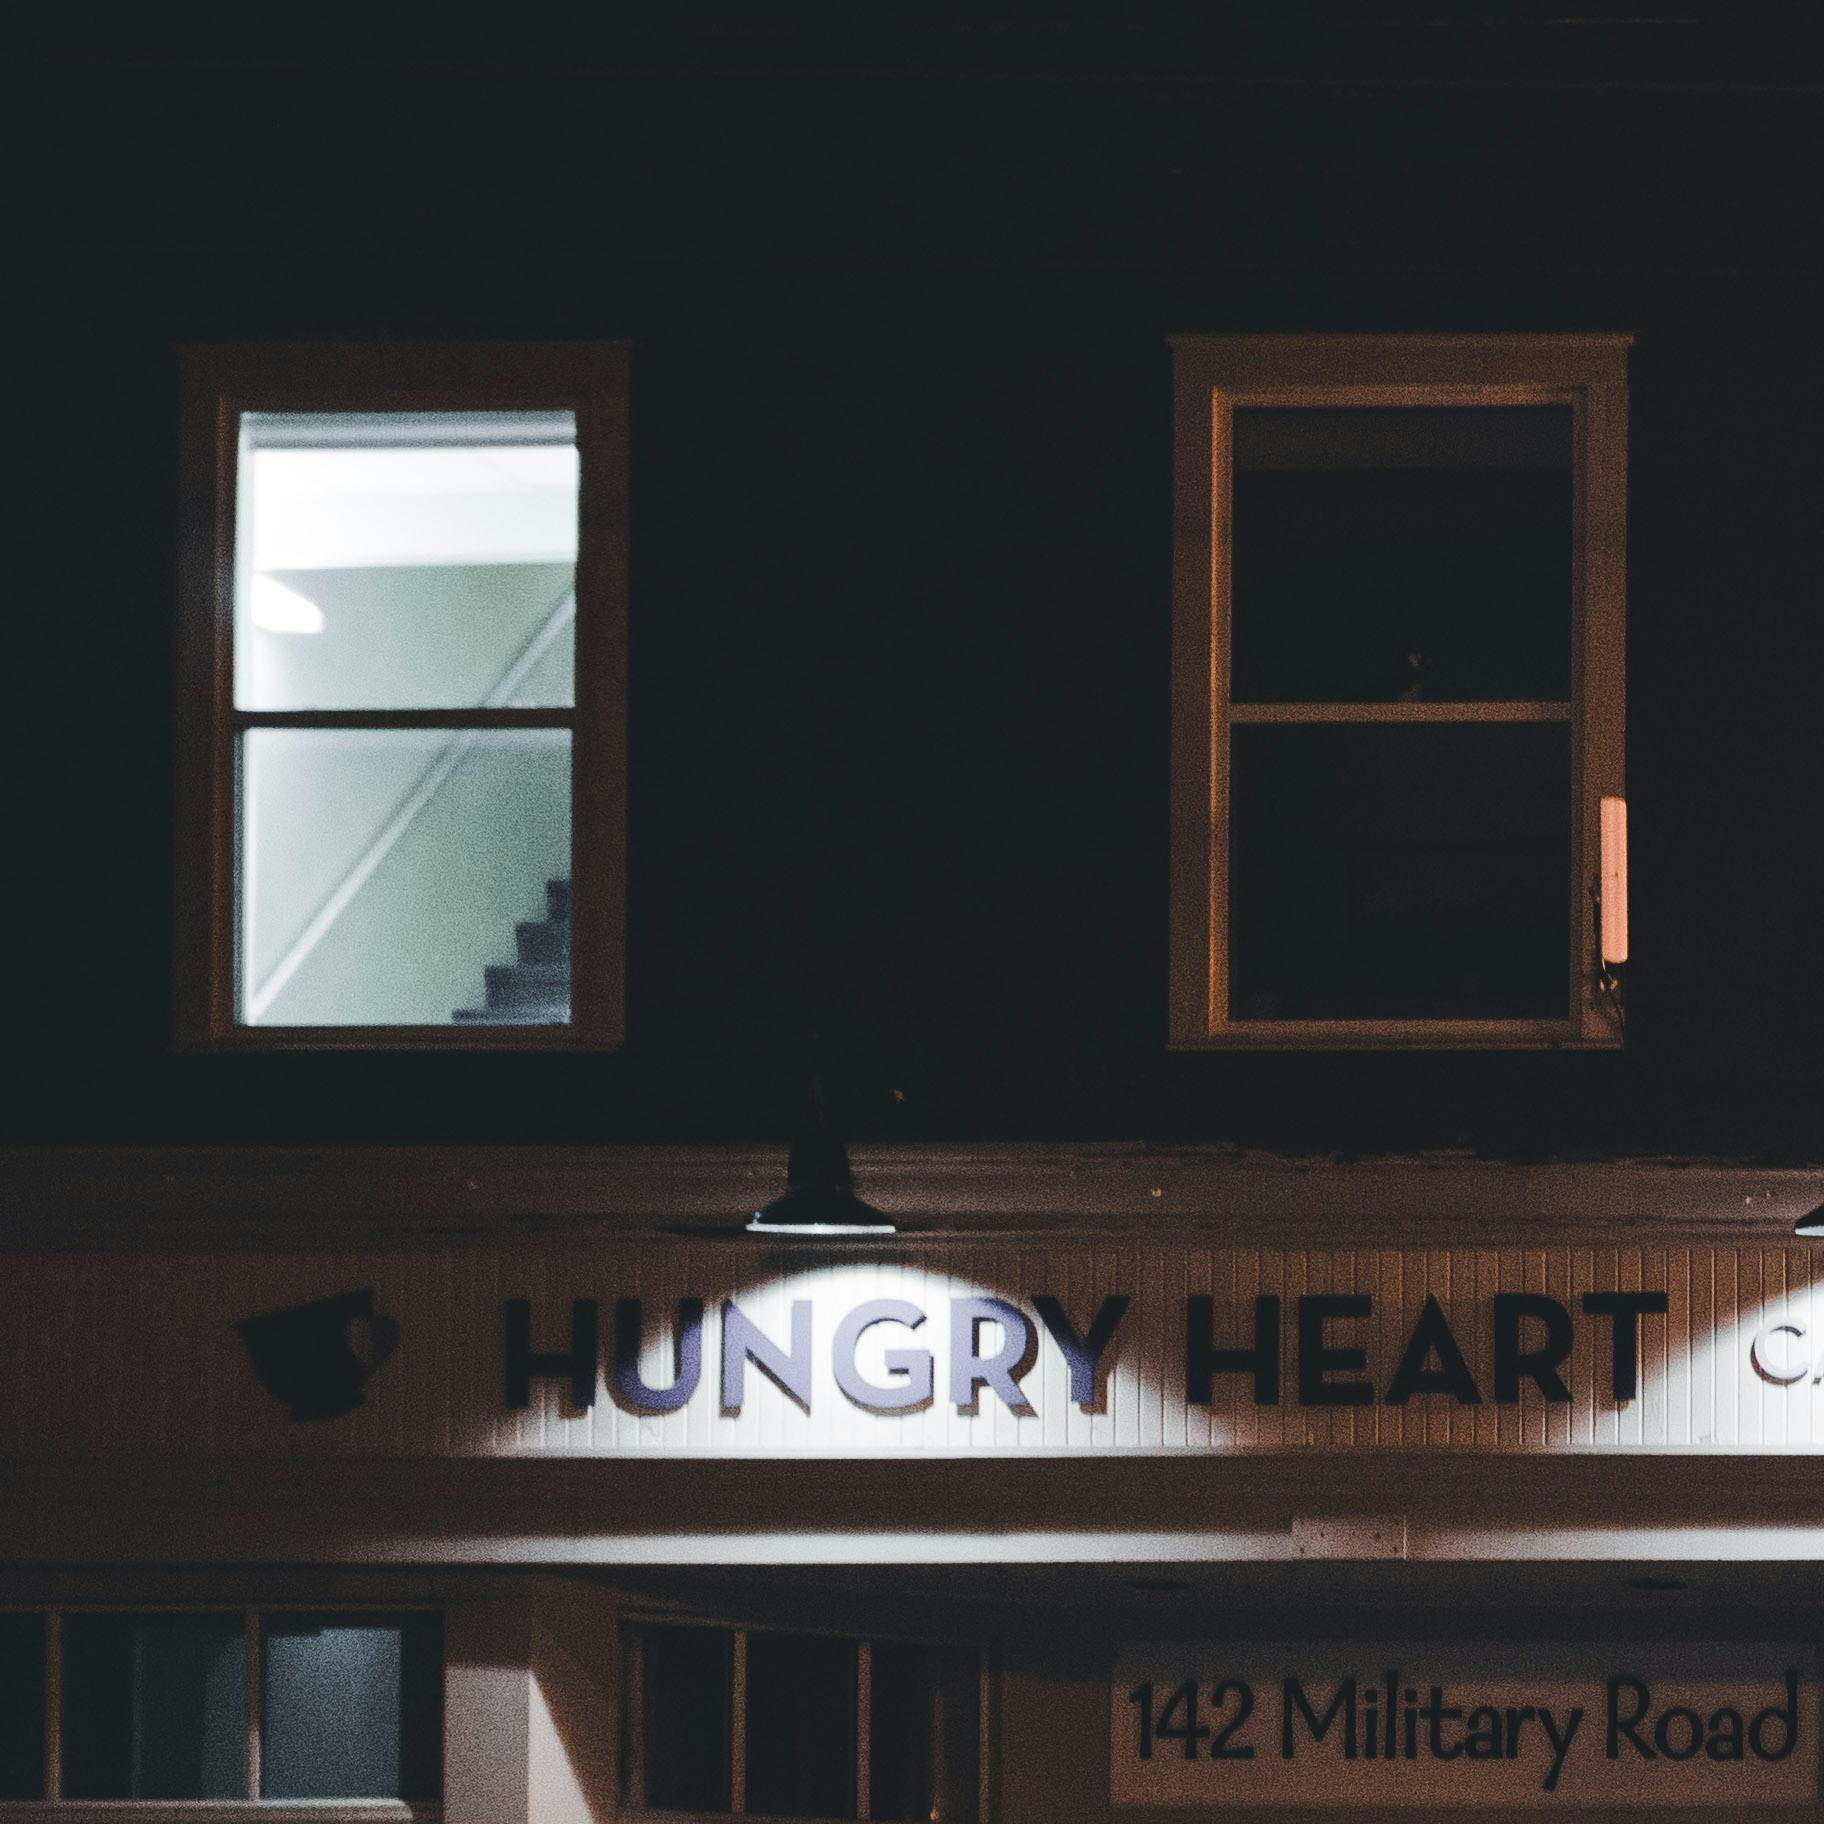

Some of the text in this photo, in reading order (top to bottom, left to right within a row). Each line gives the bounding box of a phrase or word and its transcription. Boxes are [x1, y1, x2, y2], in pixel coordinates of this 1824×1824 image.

[504, 1293, 1668, 1410] HUNGRY HEART
[1129, 1669, 1798, 1791] 142 Military Road
